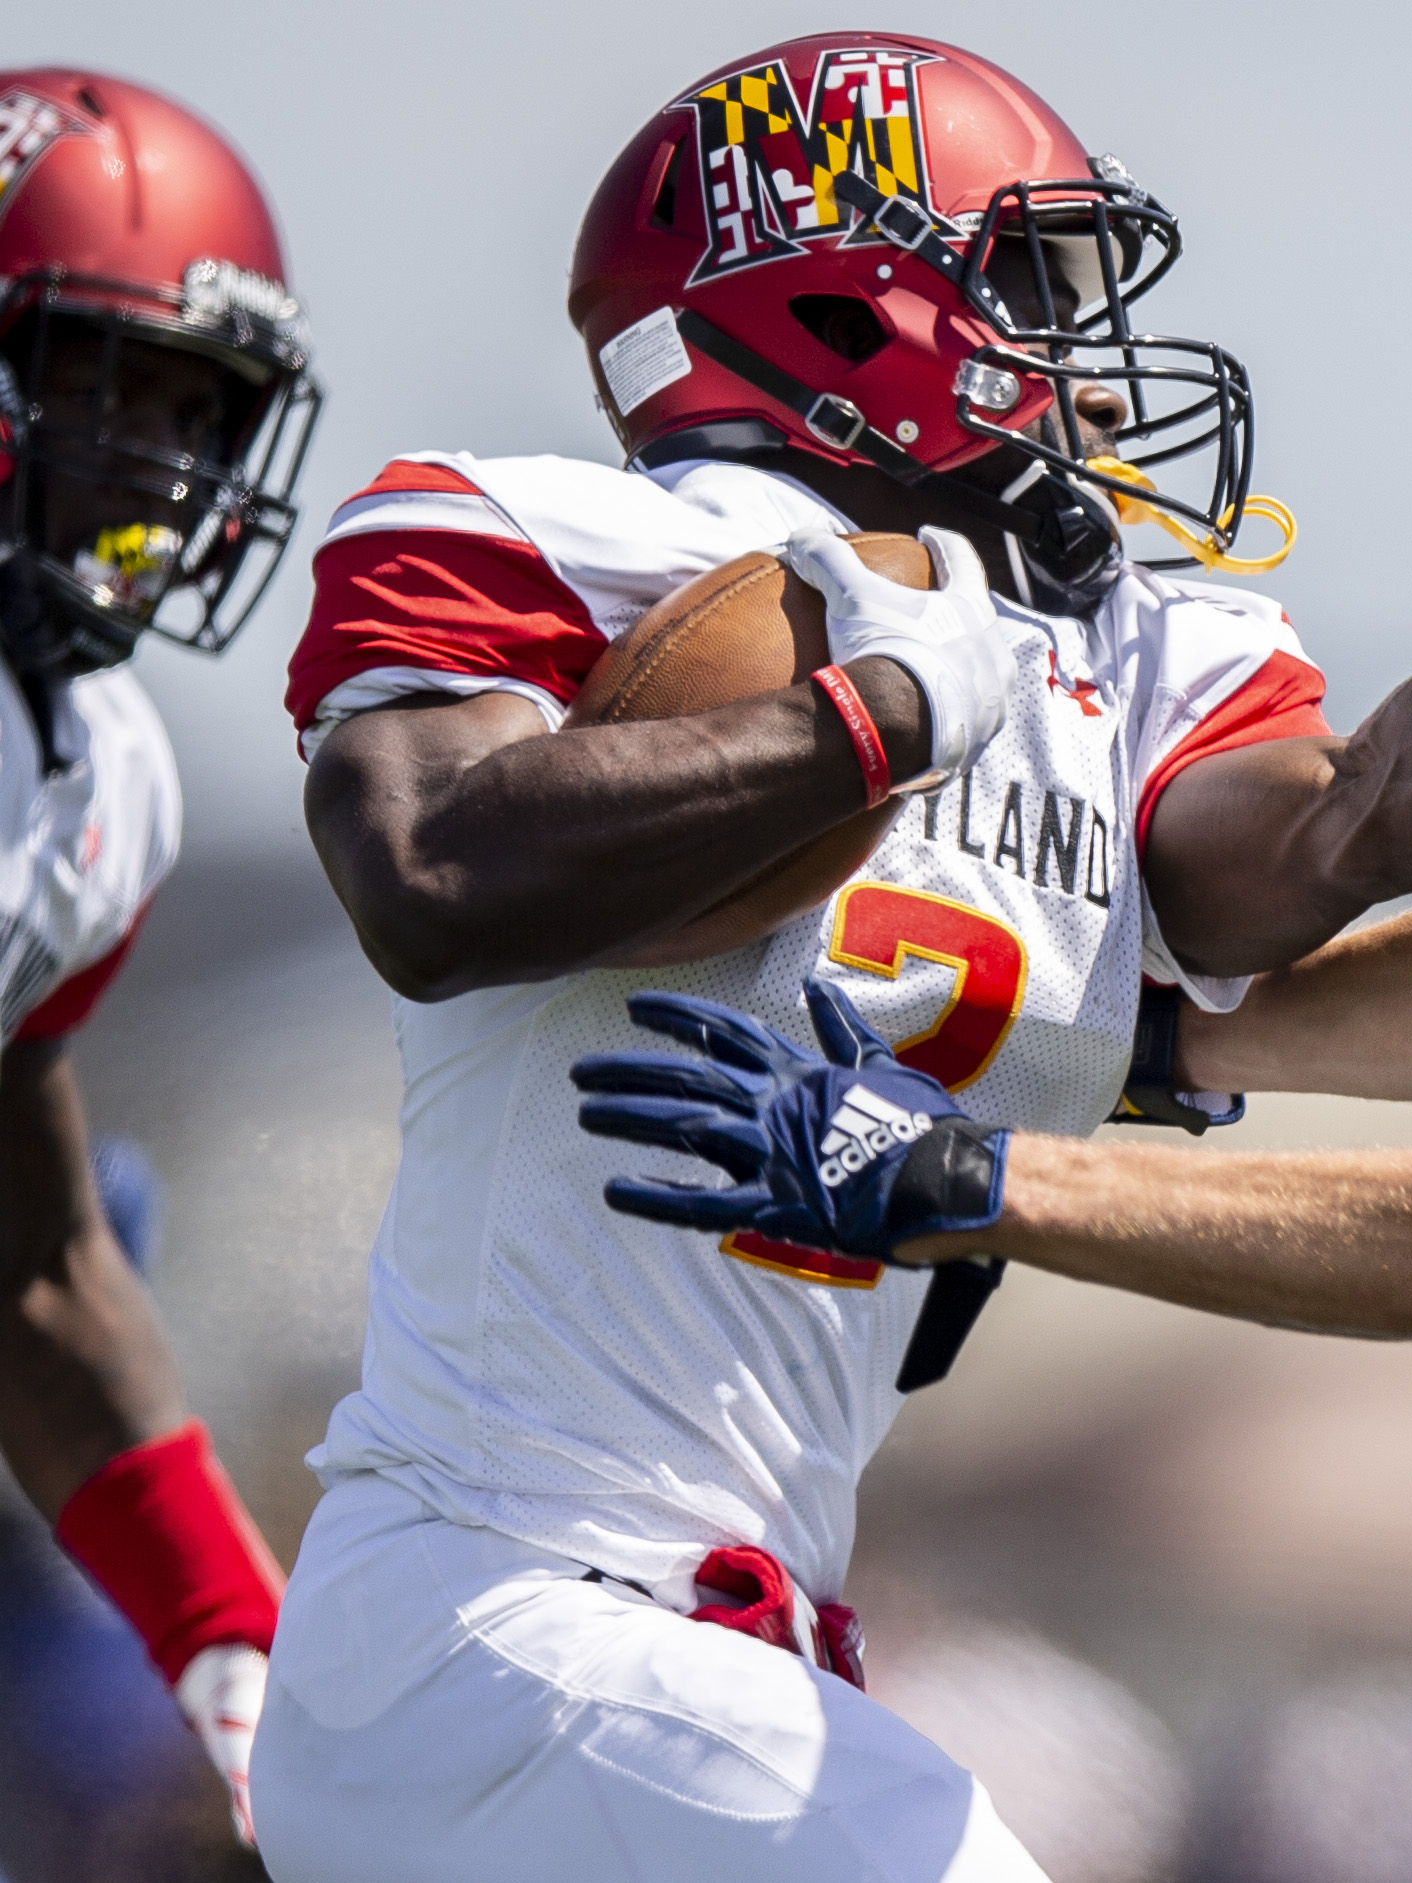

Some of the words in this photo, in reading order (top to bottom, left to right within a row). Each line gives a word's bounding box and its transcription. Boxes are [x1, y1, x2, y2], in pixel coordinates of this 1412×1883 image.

[664, 49, 972, 289] M
[952, 216, 983, 229] Ridd
[818, 1111, 933, 1187] adidas
